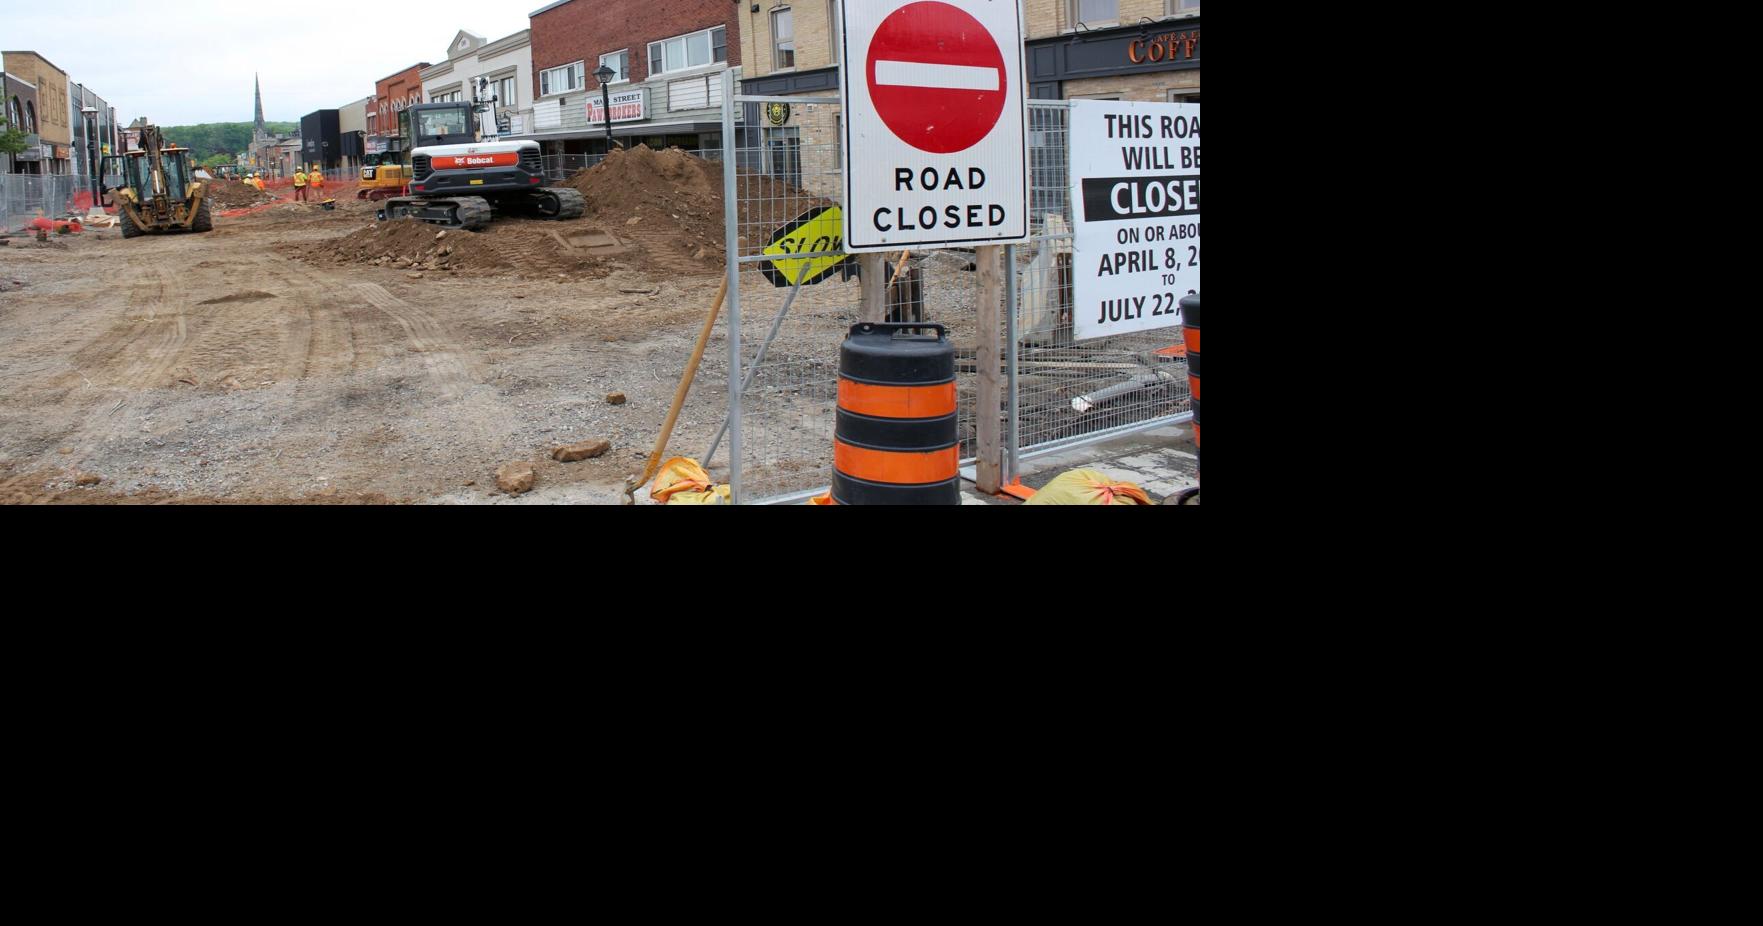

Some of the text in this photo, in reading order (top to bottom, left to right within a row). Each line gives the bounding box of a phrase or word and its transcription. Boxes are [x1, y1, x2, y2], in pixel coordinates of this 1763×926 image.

[613, 93, 641, 102] STREET
[1104, 114, 1153, 139] THIS
[467, 156, 494, 165] Bobcat
[1121, 146, 1200, 170] WILL BE
[363, 169, 374, 178] CAT
[895, 166, 986, 191] ROAD
[1110, 180, 1200, 215] CLOSE
[873, 204, 1006, 232] CLOSED
[1117, 222, 1200, 244] ON OR ABO
[1097, 245, 1200, 277] APRIL 8, 2
[1161, 273, 1175, 286] TO
[1097, 292, 1180, 324] JULY 22,
